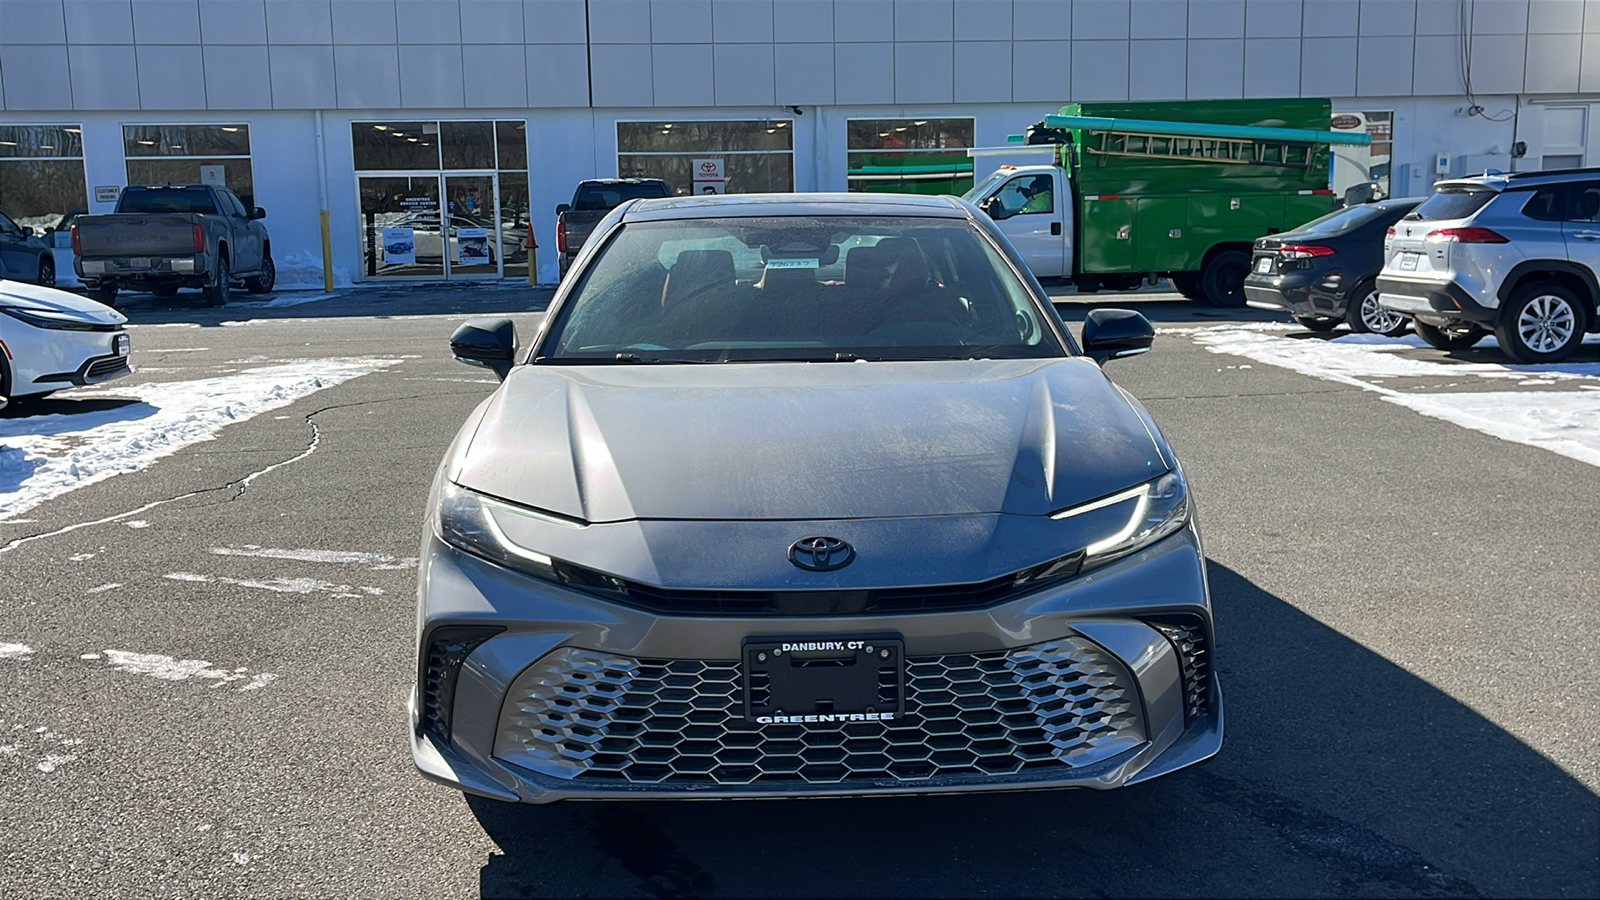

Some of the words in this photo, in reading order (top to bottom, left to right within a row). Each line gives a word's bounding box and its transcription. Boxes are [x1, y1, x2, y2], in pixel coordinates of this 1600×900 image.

[782, 641, 844, 652] DANBURY,
[847, 641, 865, 650] CT
[756, 712, 895, 724] GREENTREE
